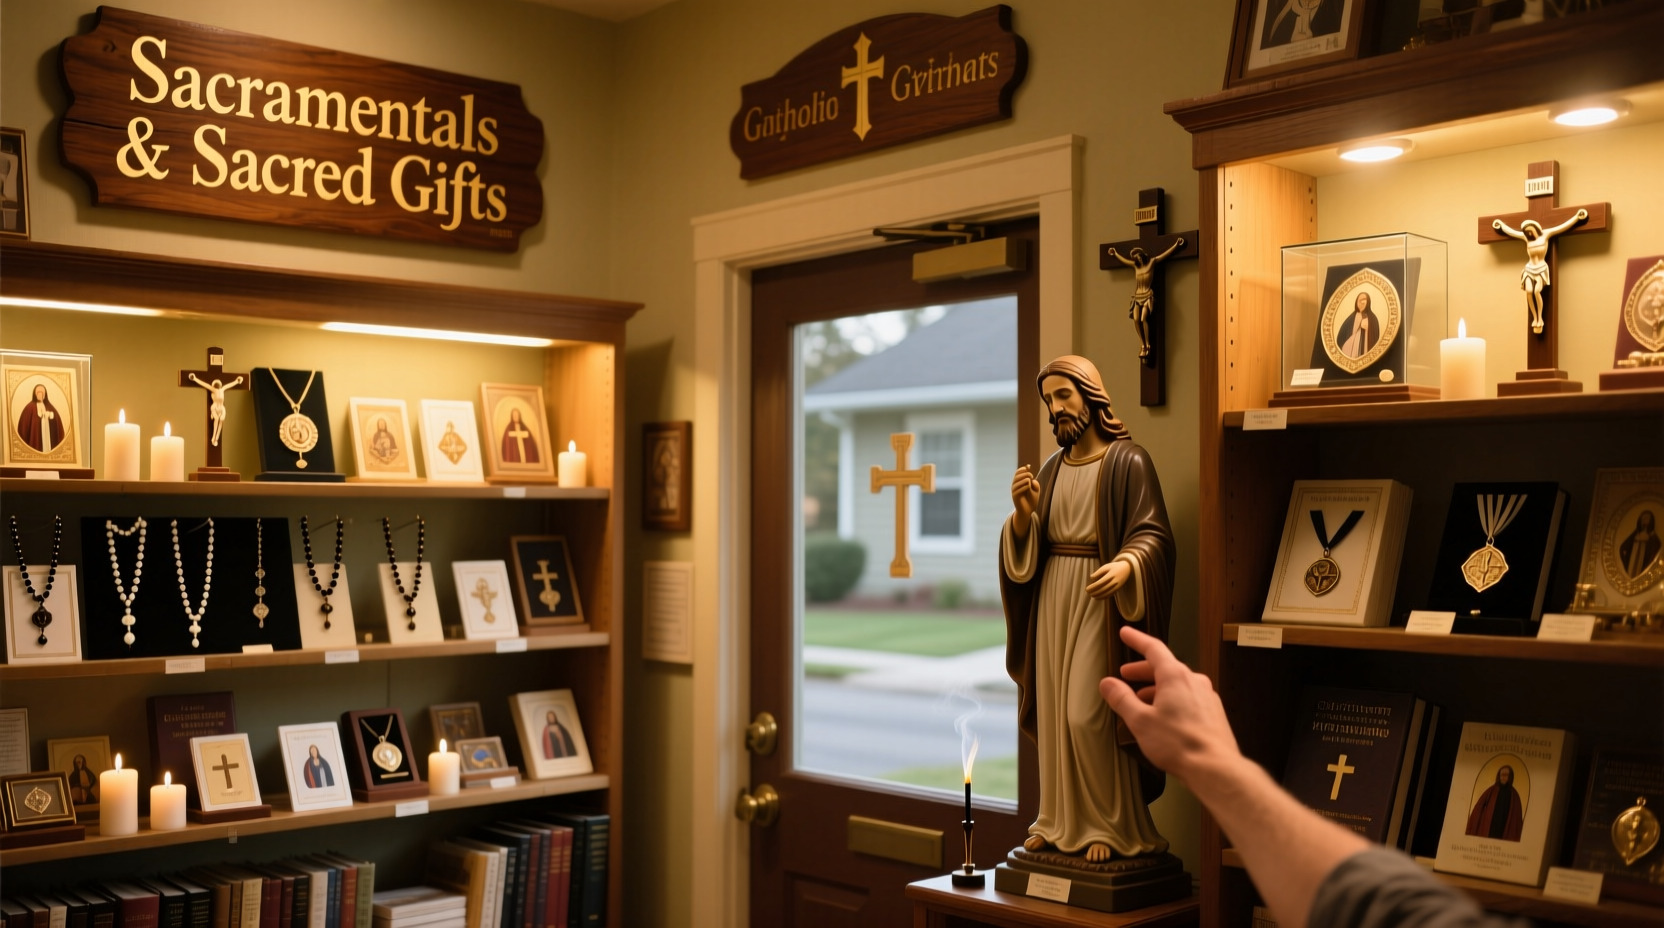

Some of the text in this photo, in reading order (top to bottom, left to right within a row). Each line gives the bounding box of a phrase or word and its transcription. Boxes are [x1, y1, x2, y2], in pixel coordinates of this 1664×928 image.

[130, 35, 499, 156] Sacramentals
[116, 117, 507, 231] & Sacred Gifts
